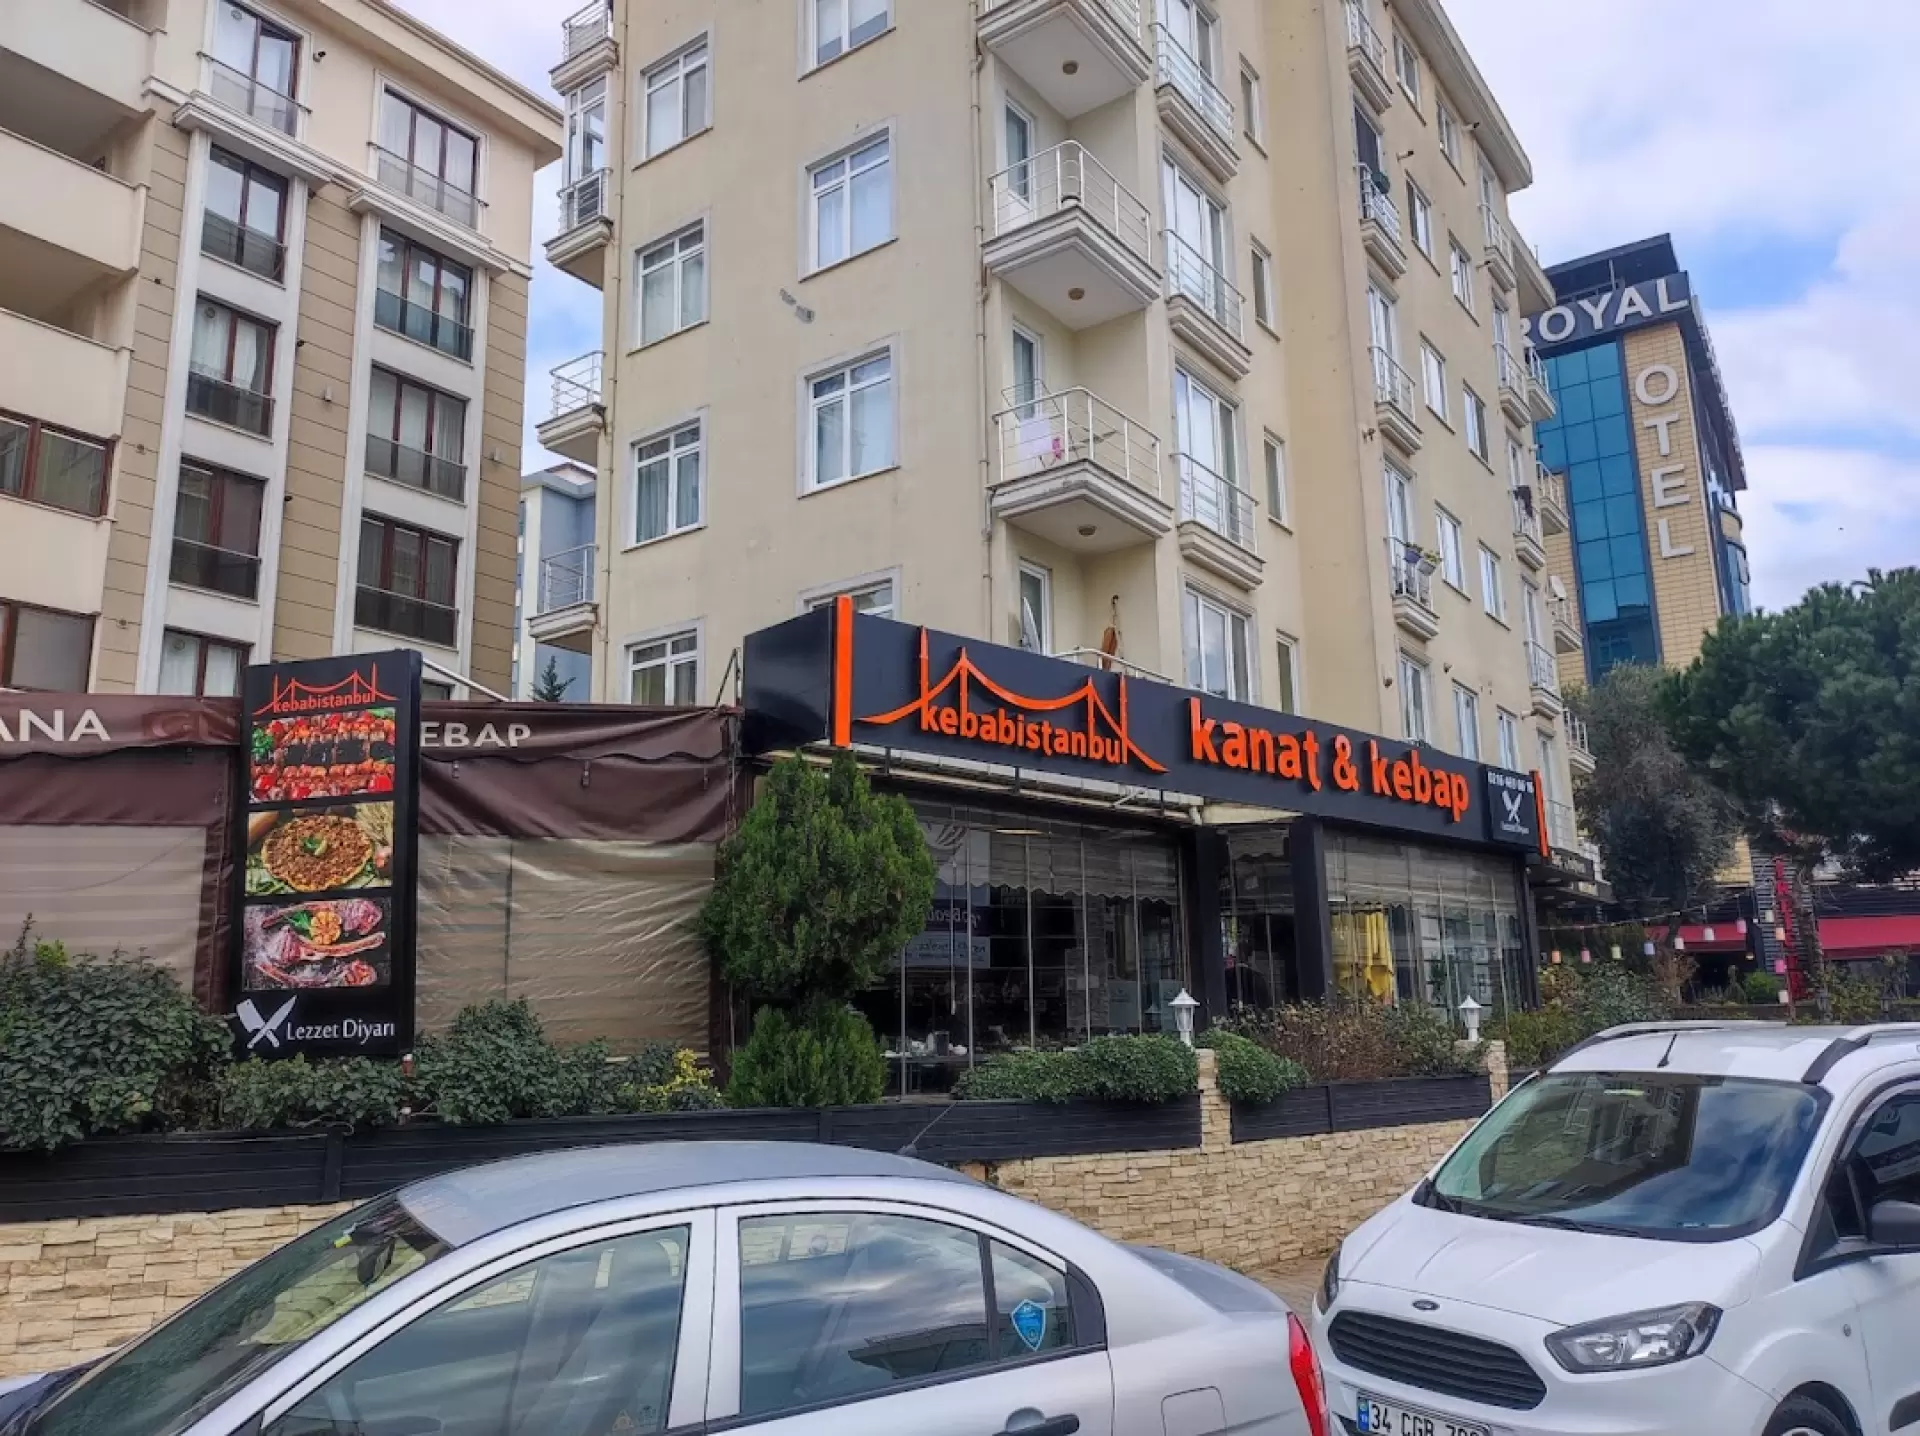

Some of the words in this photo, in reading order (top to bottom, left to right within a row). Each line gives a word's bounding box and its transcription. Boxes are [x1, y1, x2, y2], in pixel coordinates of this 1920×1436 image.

[1635, 365, 1694, 558] OTEL
[273, 679, 376, 713] kebabistanbul
[920, 668, 1128, 765] kebabistanbul
[1190, 696, 1321, 792] kanat
[1333, 736, 1360, 792] &
[1370, 739, 1470, 823] kebap
[286, 1021, 339, 1041] Lezzet
[342, 1019, 396, 1046] Diyarı
[1371, 1403, 1392, 1433] 34
